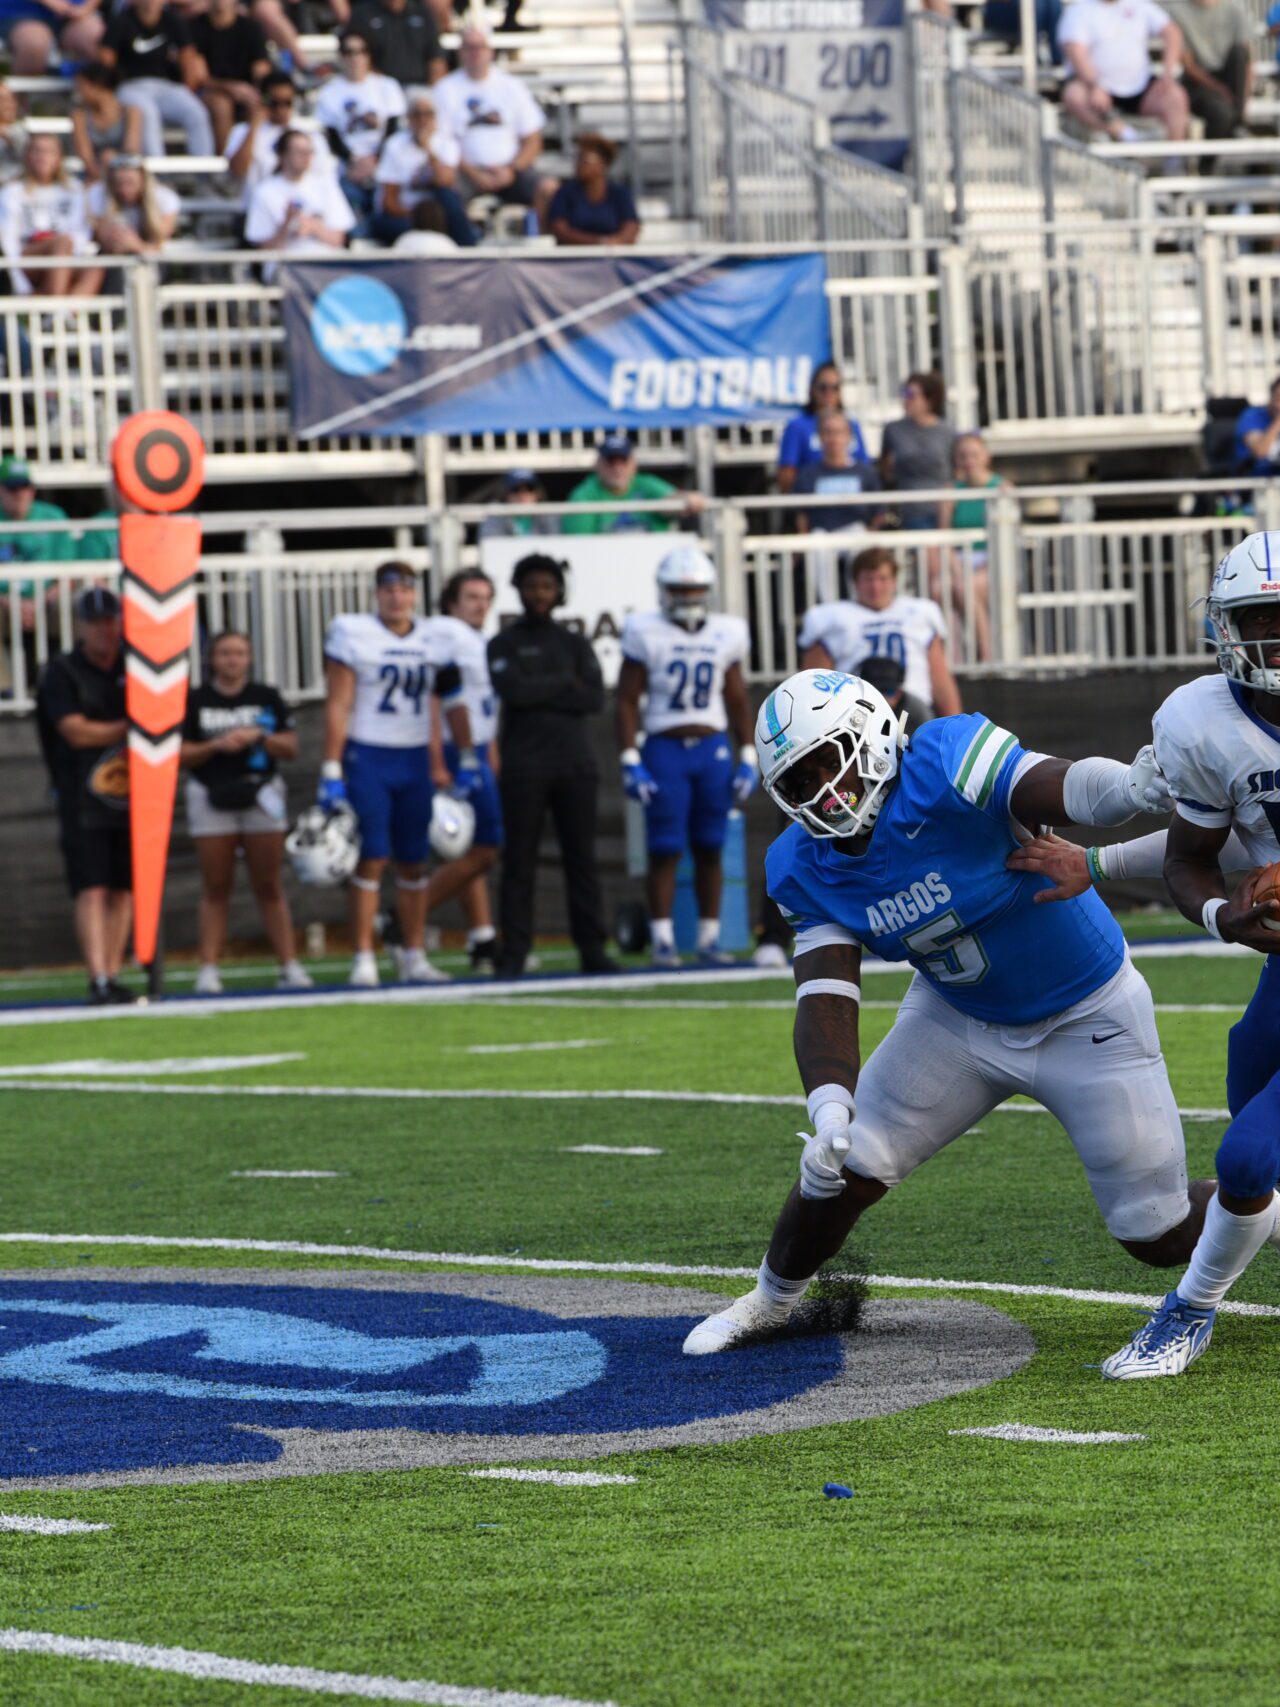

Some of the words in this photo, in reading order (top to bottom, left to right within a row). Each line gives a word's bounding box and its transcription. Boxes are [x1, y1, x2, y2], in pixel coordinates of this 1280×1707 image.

[737, 44, 787, 92] 01
[820, 41, 892, 90] 200
[610, 355, 812, 410] FOOTBALL
[379, 663, 426, 714] 24
[667, 660, 714, 710] 28
[866, 872, 952, 937] ARGOS
[900, 907, 991, 985] 5
